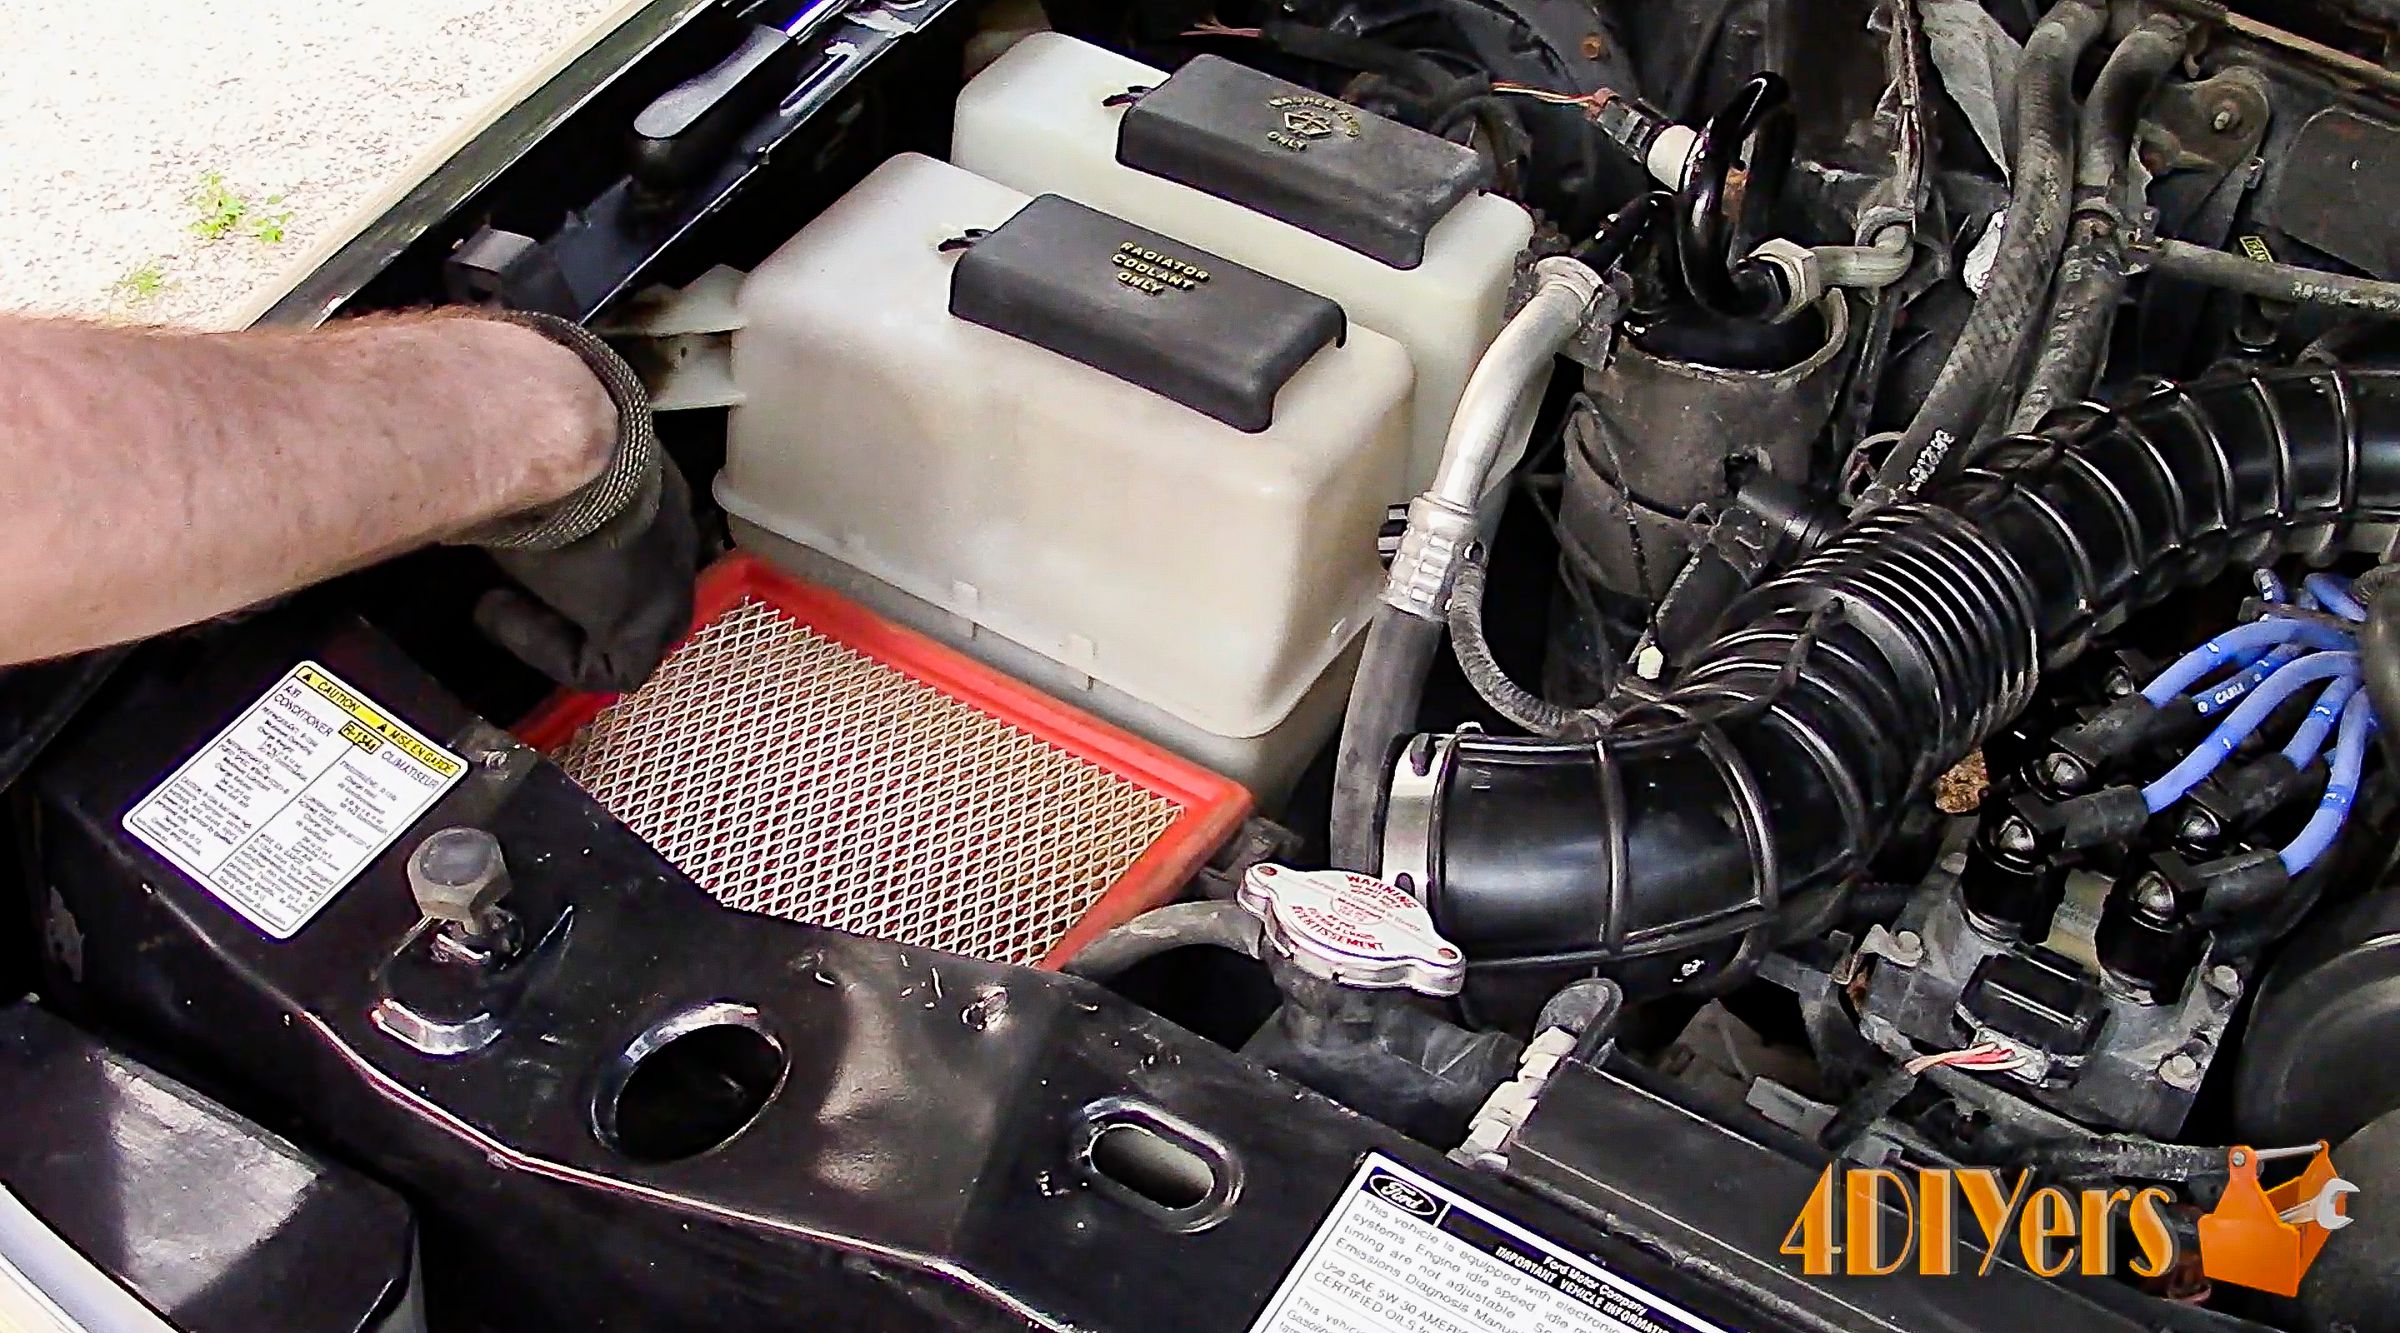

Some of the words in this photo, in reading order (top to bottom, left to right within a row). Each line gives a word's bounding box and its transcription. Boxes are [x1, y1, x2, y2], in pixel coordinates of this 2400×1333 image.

[1266, 130, 1307, 151] ONLY
[1111, 253, 1195, 289] COOLANT
[1119, 240, 1210, 281] RADIATOR
[1116, 271, 1164, 294] ONLY
[274, 694, 334, 737] CONDITIONER
[317, 681, 360, 712] CAUTION
[382, 751, 439, 789] CLIMATISEUR
[1346, 874, 1418, 908] WARNING
[1380, 1181, 1424, 1211] Ford
[1353, 1214, 1405, 1244] systems
[1416, 1244, 1460, 1272] Engine
[1466, 1272, 1489, 1287] idle
[1495, 1287, 1536, 1312] speed
[1365, 1200, 1388, 1218] This
[1395, 1218, 1438, 1243] vehicle
[1460, 1251, 1521, 1285] equipped
[1525, 1285, 1550, 1302] with
[1336, 1238, 1400, 1277] Emissions
[1405, 1274, 1468, 1312] Diagnosis
[1345, 1225, 1384, 1252] timing
[1419, 1265, 1440, 1279] not
[1447, 1281, 1515, 1318] adjustable
[1349, 1273, 1374, 1292] SAE
[1496, 1247, 1557, 1283] IMPORTANT
[1560, 1279, 1604, 1308] VEHICLE
[1543, 1256, 1569, 1274] Ford
[1568, 1269, 1599, 1289] Motor
[1600, 1285, 1647, 1316] Company
[1298, 1297, 1319, 1315] This
[1315, 1272, 1383, 1312] CERTIFIED
[1386, 1310, 1415, 1330] OILS
